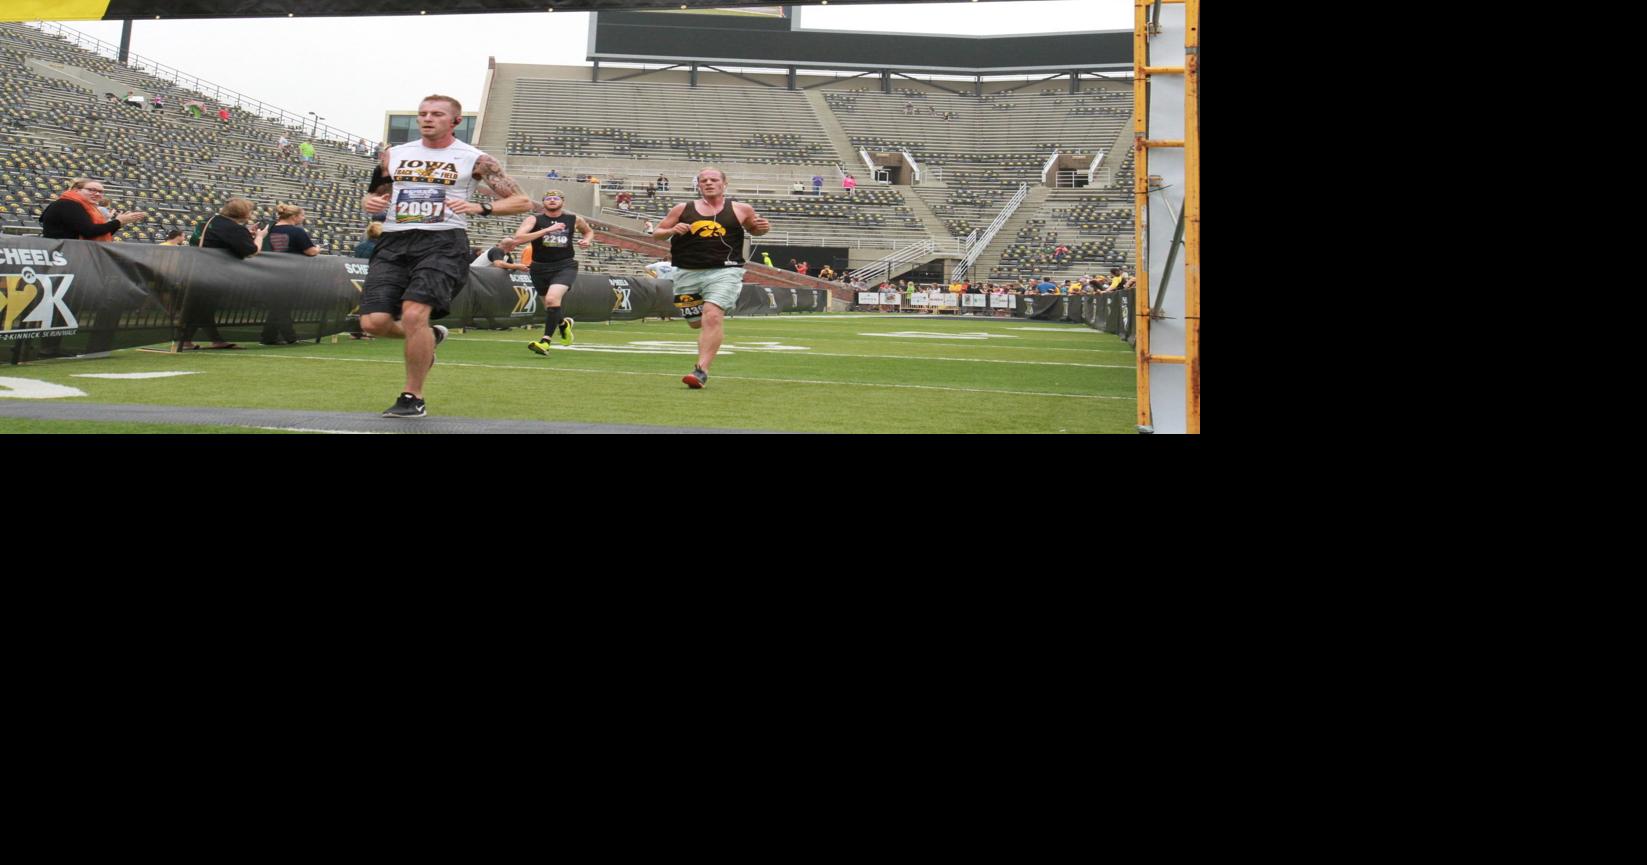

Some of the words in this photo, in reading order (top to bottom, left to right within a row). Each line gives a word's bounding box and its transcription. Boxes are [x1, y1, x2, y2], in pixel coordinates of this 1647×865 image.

[400, 160, 457, 172] IOWA
[398, 202, 443, 216] 2097
[0, 248, 67, 266] CHEELS
[344, 264, 369, 274] SCHE
